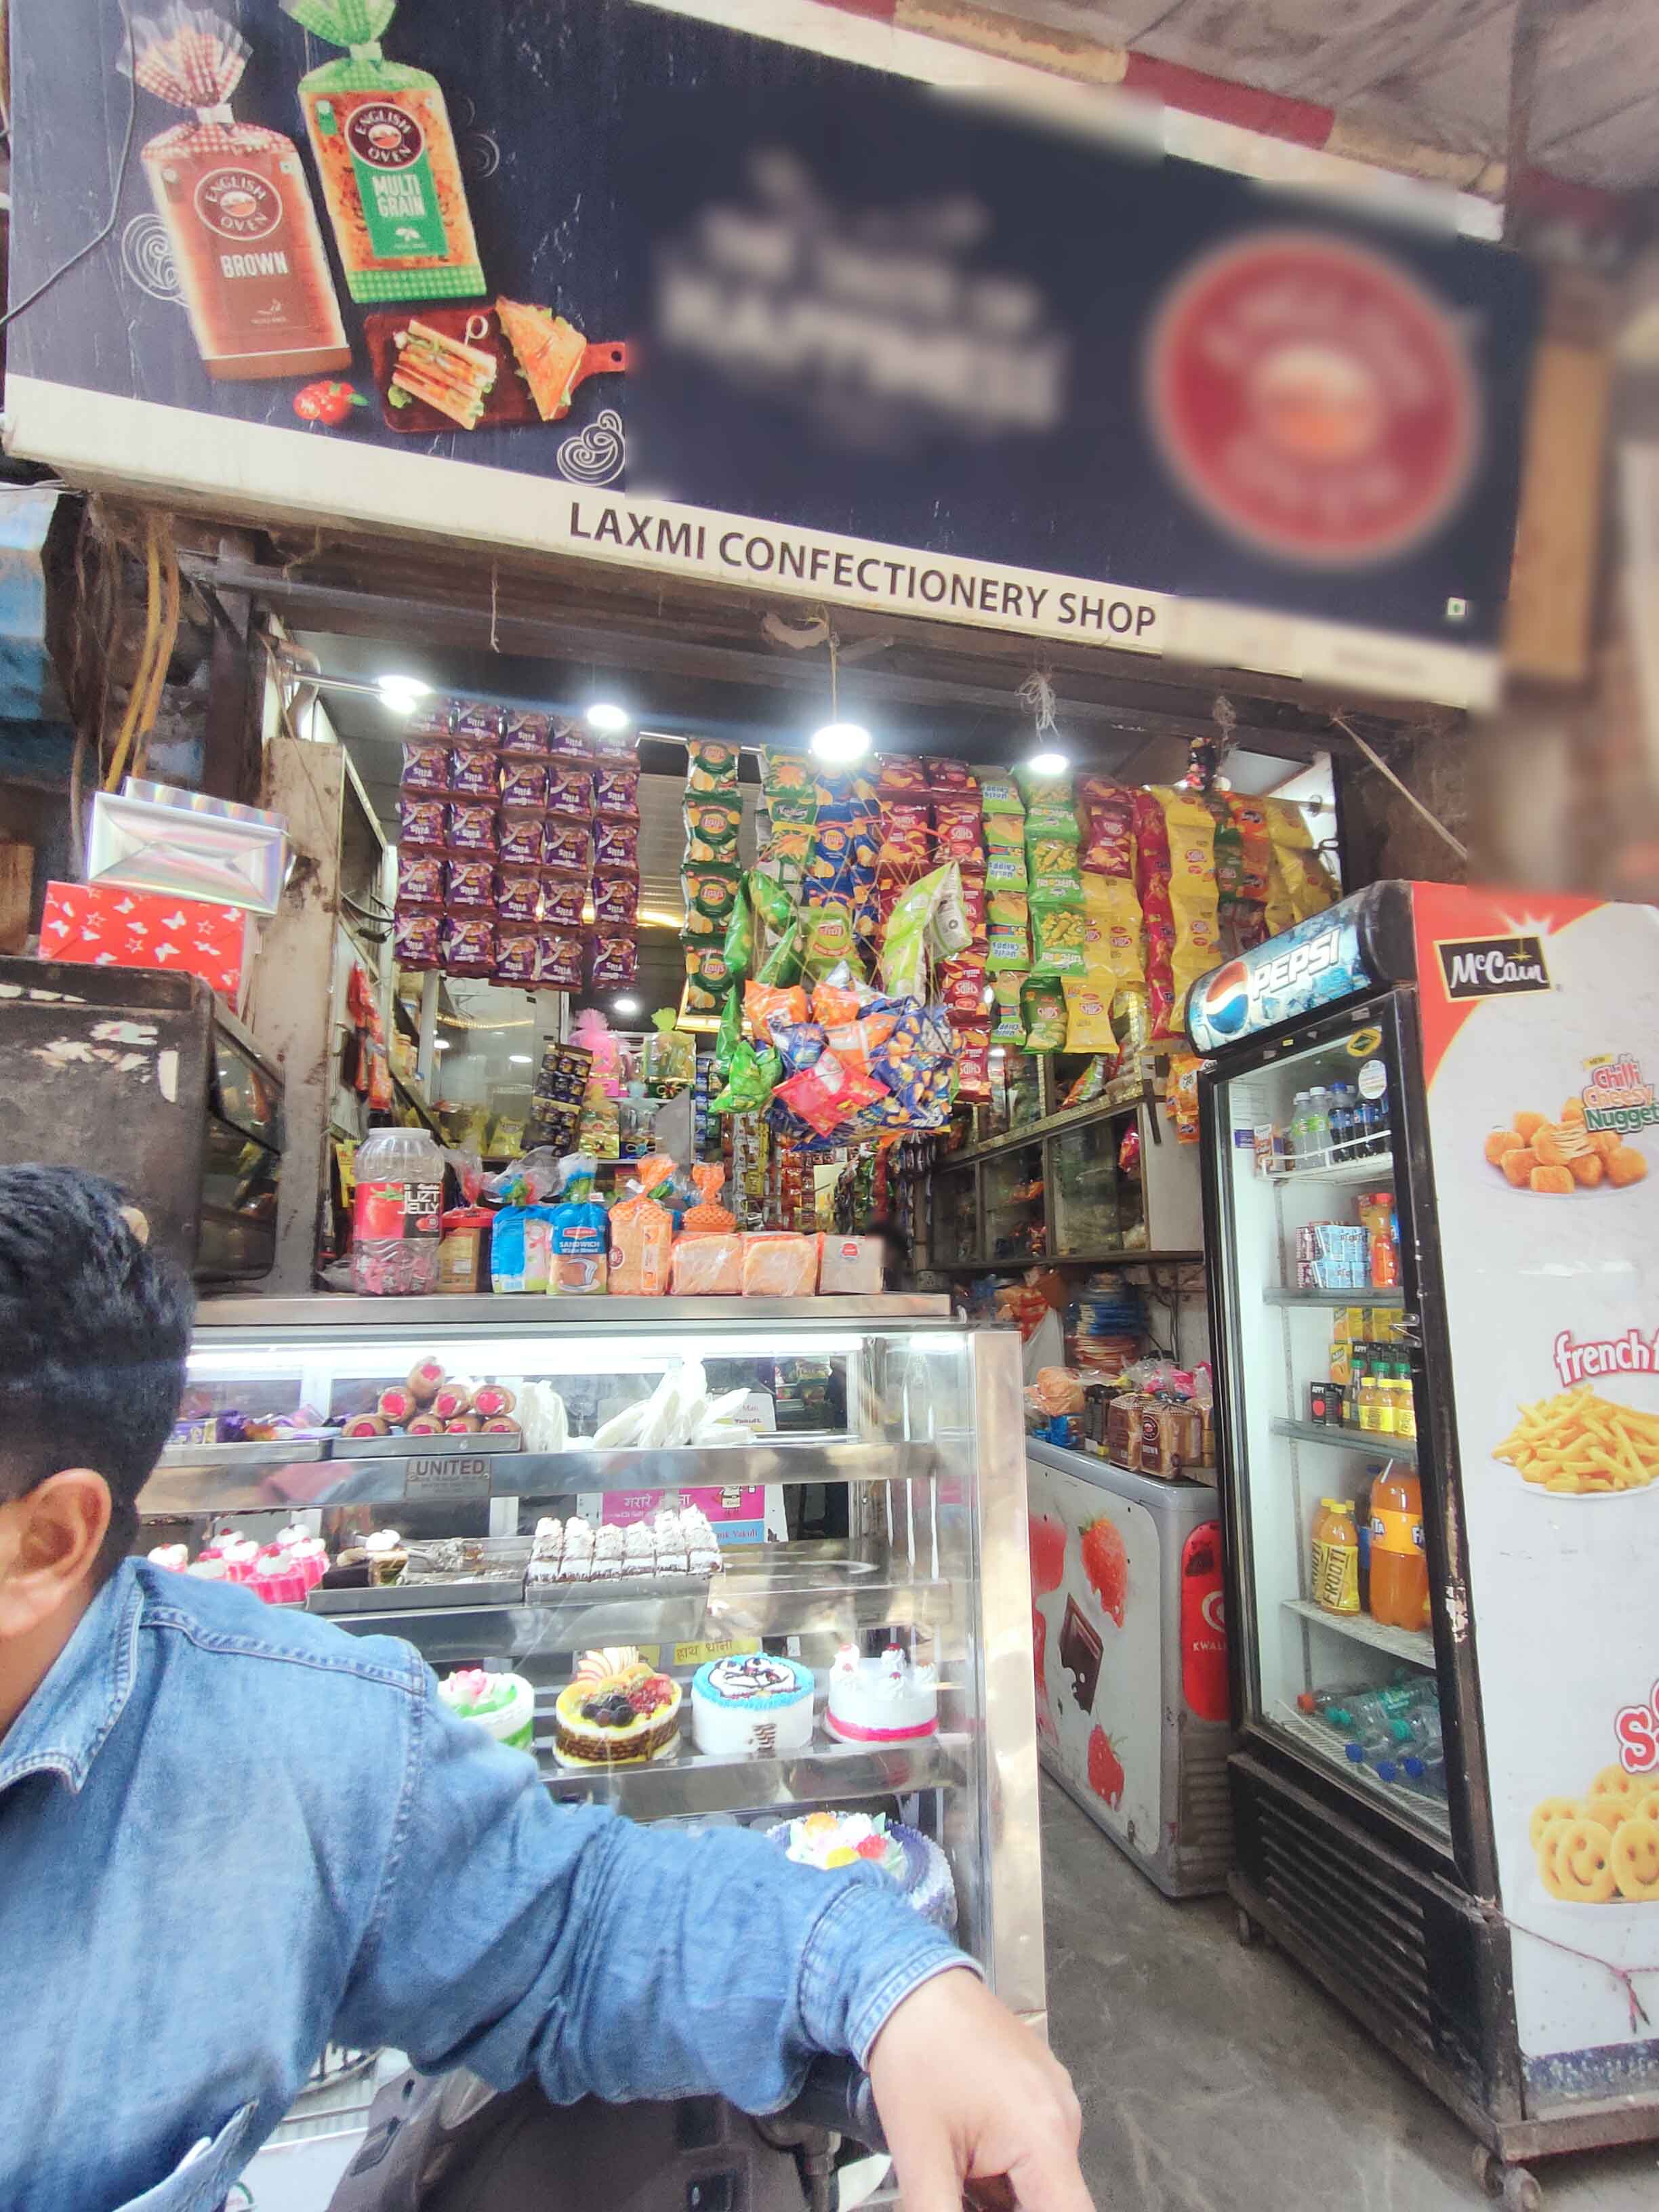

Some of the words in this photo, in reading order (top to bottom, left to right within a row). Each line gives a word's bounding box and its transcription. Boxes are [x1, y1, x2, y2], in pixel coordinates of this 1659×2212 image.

[354, 109, 412, 135] ENGLISH
[368, 144, 412, 163] OVEN
[205, 176, 267, 203] ENGLISH
[373, 173, 421, 197] MULTI
[377, 195, 426, 218] GRAIN
[220, 213, 268, 232] OVEN
[220, 250, 289, 279] BROWN
[570, 501, 705, 560] LAXMI
[719, 531, 1049, 619] CONFECTIONERY
[1057, 592, 1156, 636] SHOP
[1252, 928, 1340, 1000] PEPSI
[1450, 950, 1547, 989] McCain
[998, 1023, 1021, 1031] Chipp
[1593, 1061, 1641, 1089] Chilli
[1584, 1085, 1652, 1107] Cheesy
[397, 1202, 440, 1214] JELLY
[1555, 1330, 1651, 1387] french
[417, 1459, 485, 1475] UNITED
[1323, 1547, 1347, 1605] FROOTI
